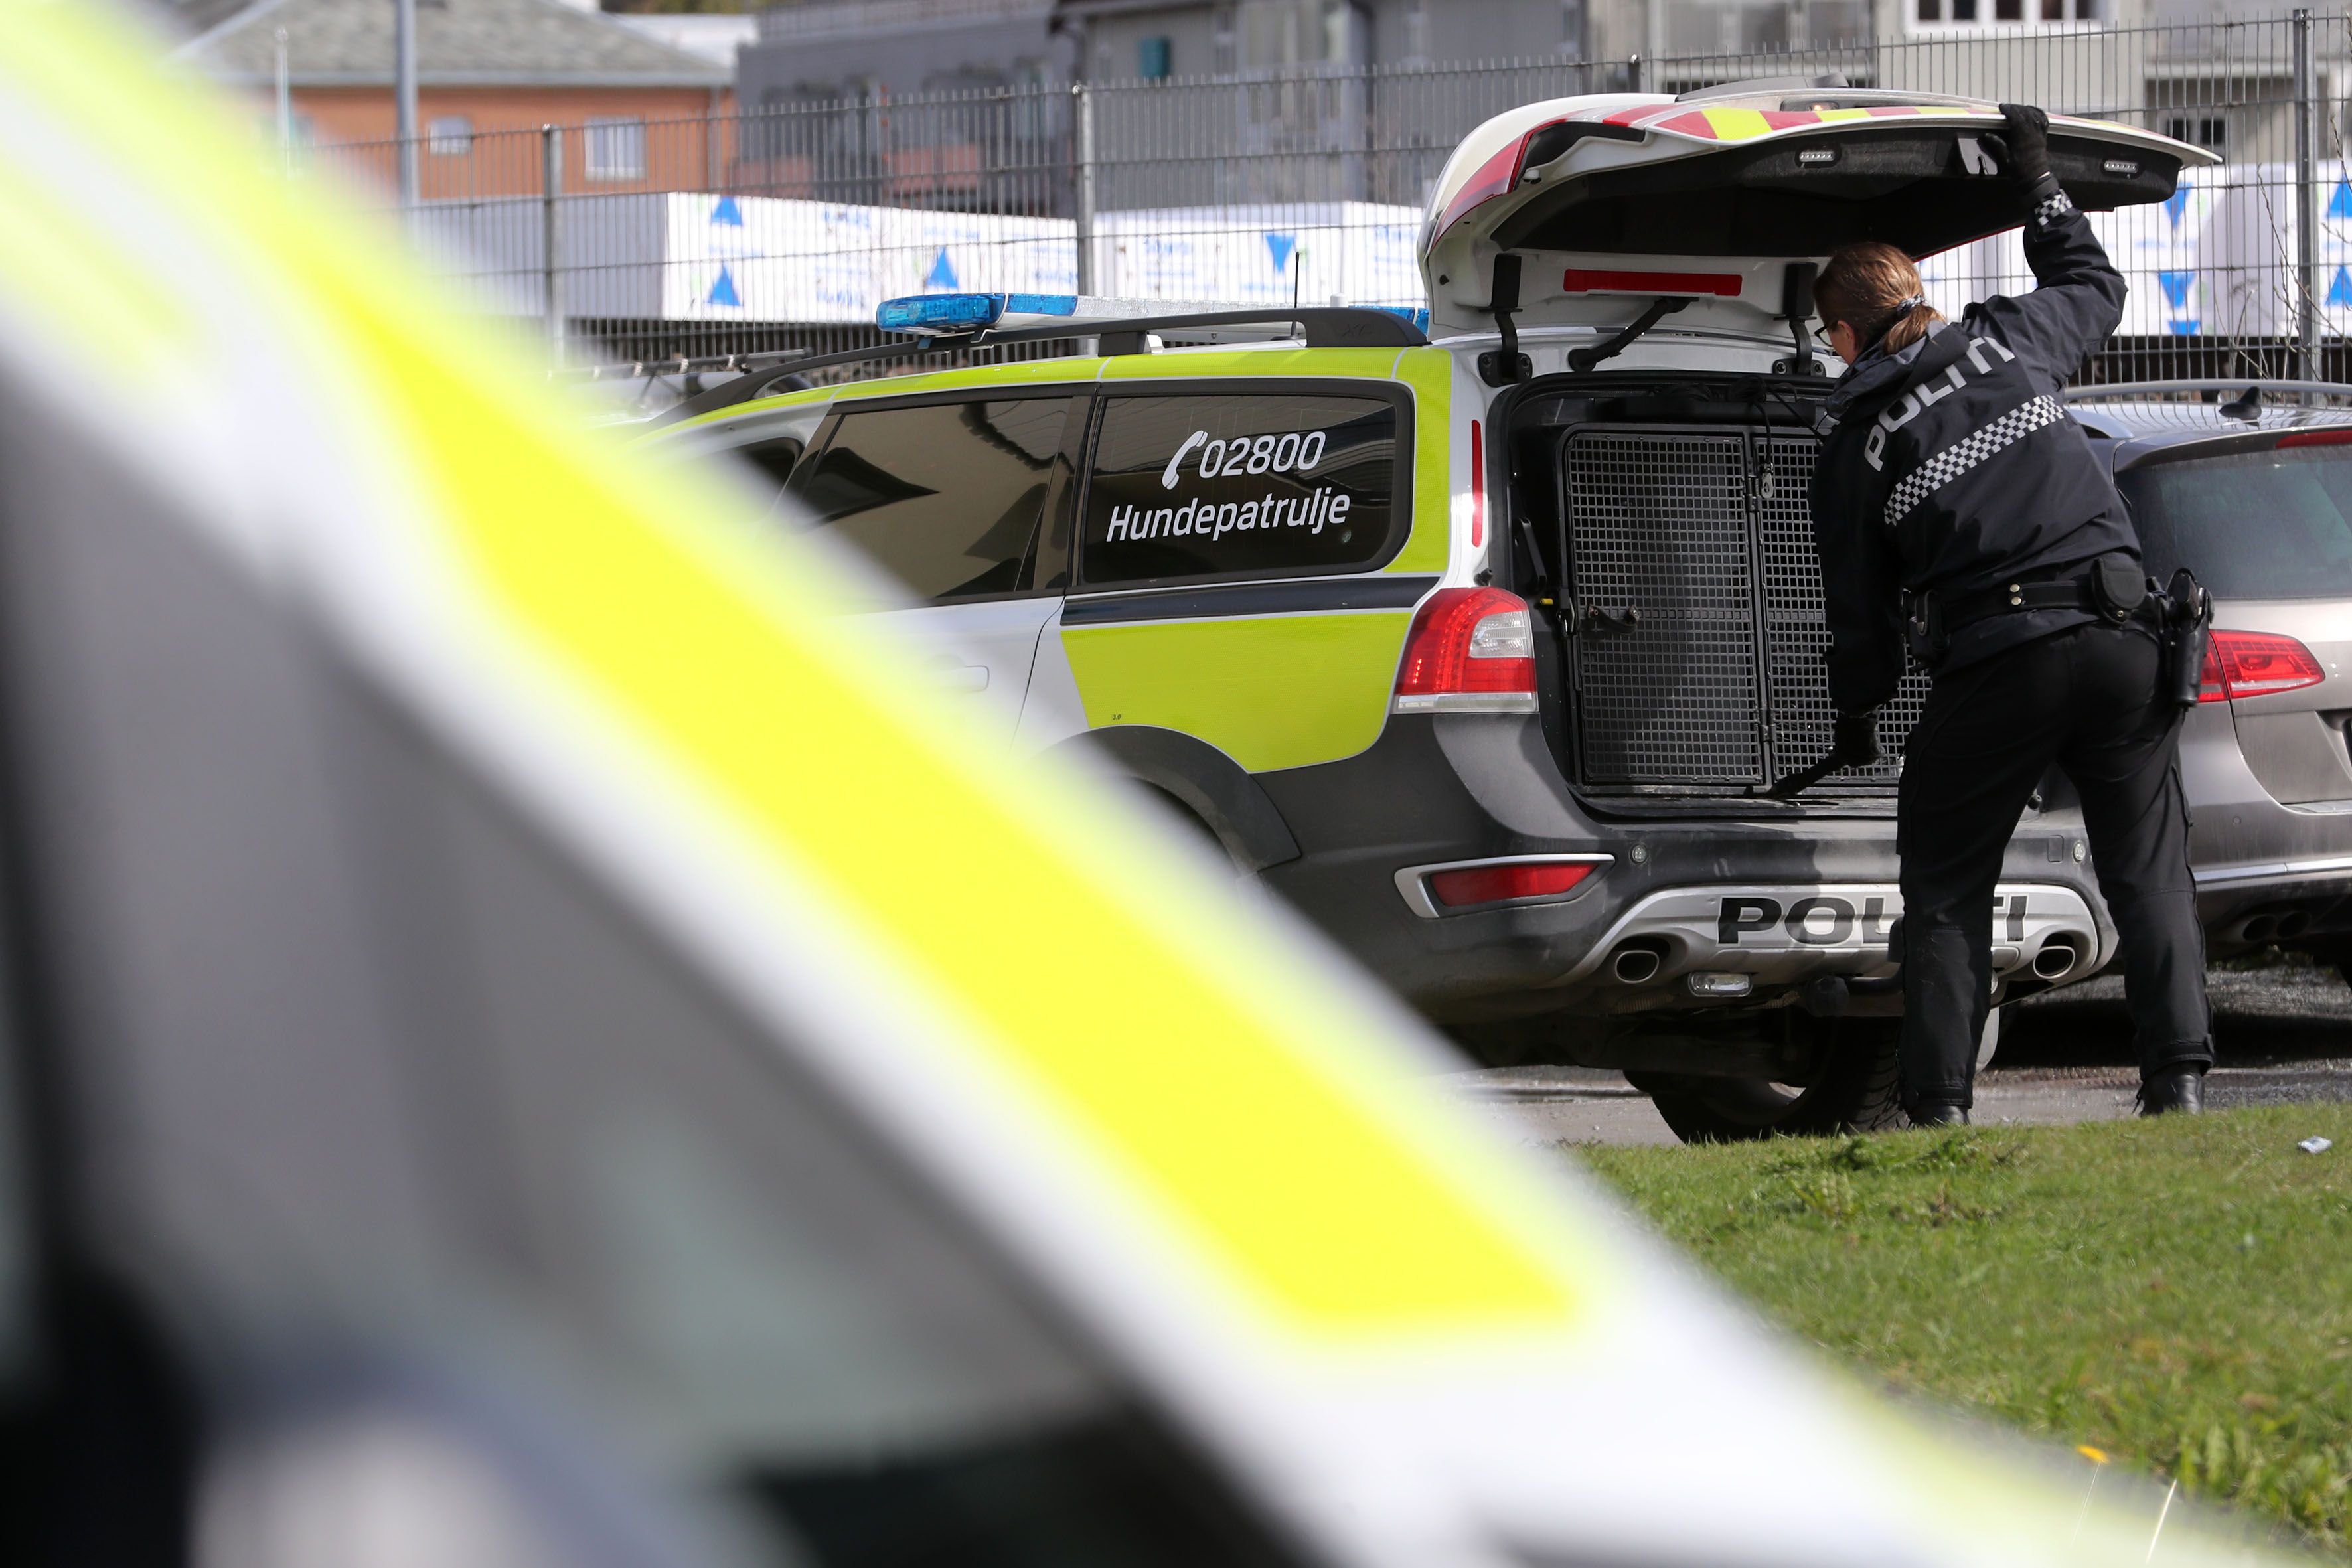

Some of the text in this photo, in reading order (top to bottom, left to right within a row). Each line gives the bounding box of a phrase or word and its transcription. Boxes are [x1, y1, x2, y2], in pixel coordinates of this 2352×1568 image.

[1200, 431, 1326, 478] 02800
[1107, 487, 1350, 542] Hundepatrulje
[1718, 896, 2027, 943] POLI
